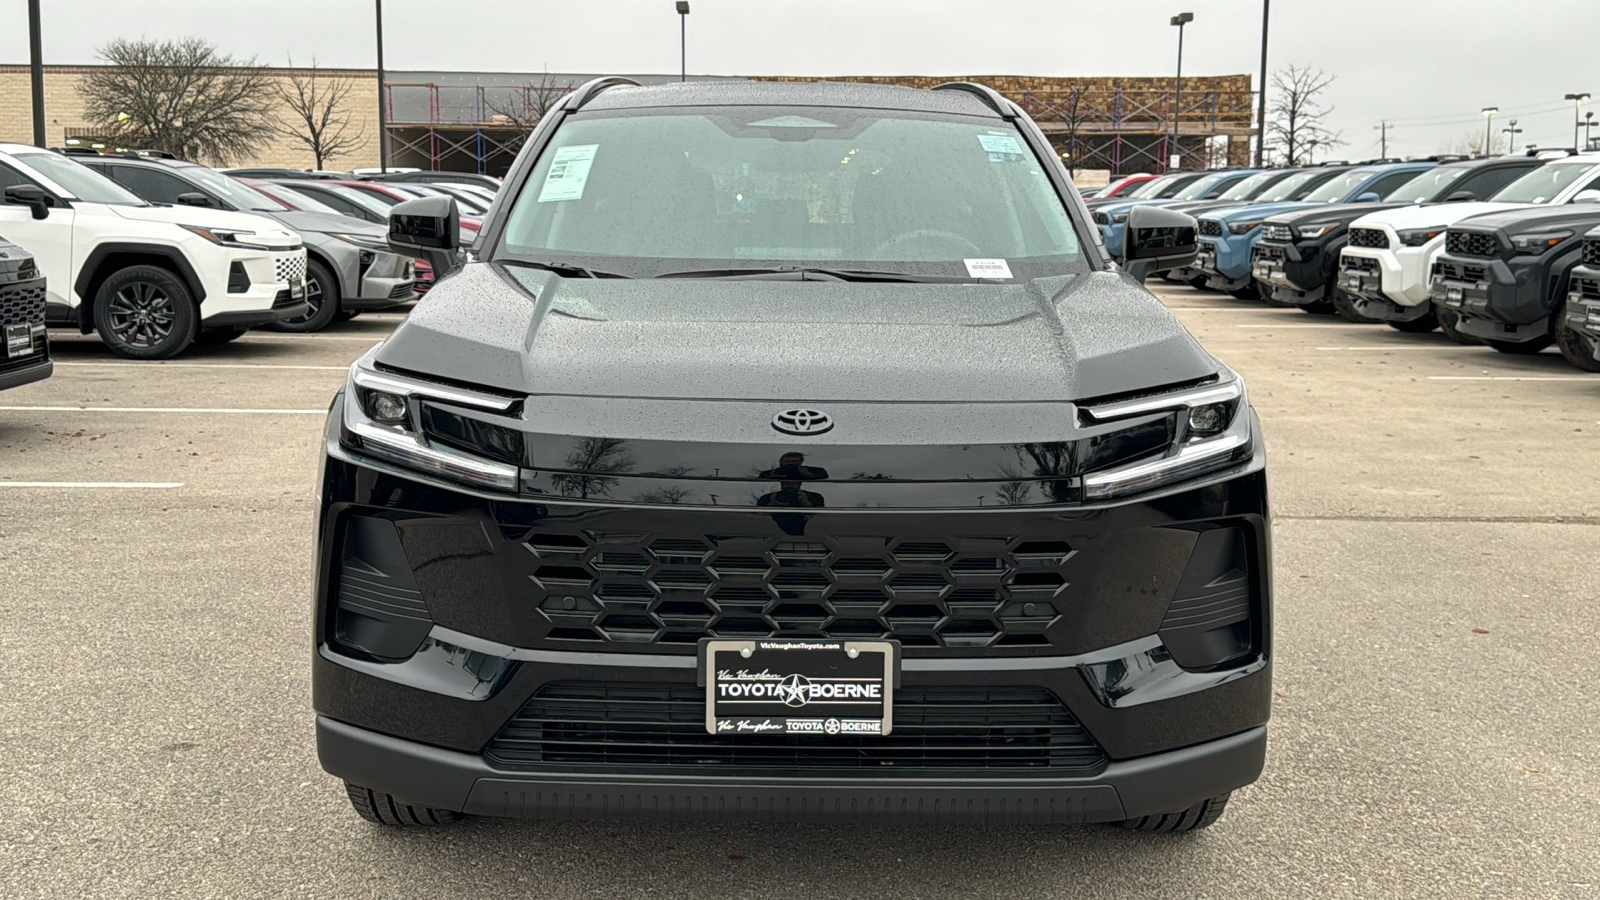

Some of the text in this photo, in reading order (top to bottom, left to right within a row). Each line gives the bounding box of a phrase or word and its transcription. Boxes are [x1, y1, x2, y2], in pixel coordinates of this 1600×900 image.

[760, 642, 840, 650] VicVaughanToyota.com
[717, 668, 782, 681] Vic Vaughan
[718, 683, 785, 697] TOYOTA
[809, 683, 881, 698] BOERNE
[717, 720, 735, 732] Vic
[736, 719, 783, 733] Vaughan
[786, 722, 824, 730] TOYOTA
[841, 722, 881, 731] BOERNE
